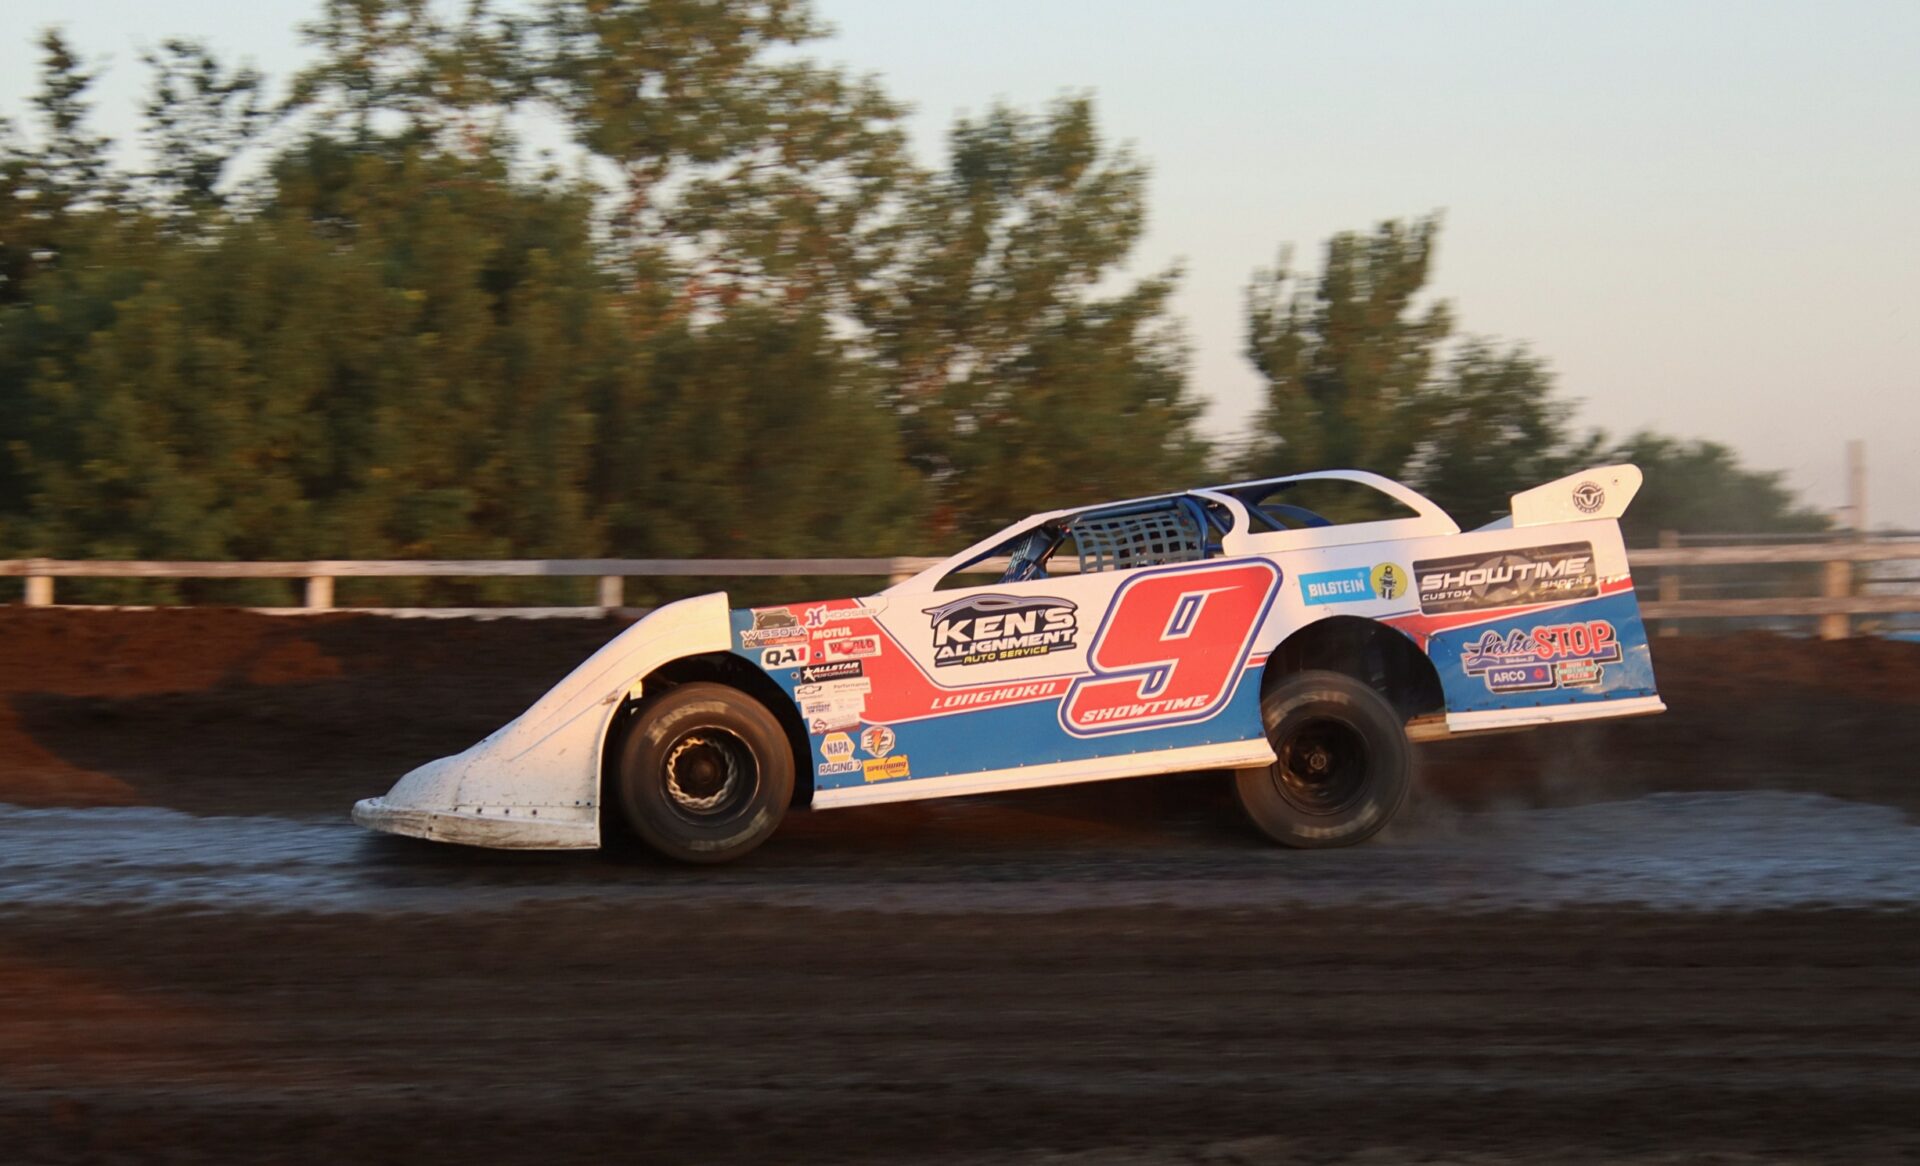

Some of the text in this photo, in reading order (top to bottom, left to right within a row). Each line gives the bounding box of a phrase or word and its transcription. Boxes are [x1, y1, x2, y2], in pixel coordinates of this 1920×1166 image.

[1421, 556, 1590, 592] SHOWTIME
[1540, 575, 1593, 589] SHOCKS
[1308, 578, 1366, 598] BILSTEIN
[1421, 588, 1473, 602] CUSTOM
[812, 627, 852, 640] MOTUL
[935, 607, 1076, 646] KEN'S
[1060, 557, 1282, 737] 9
[1466, 622, 1611, 666] Lake STOP
[765, 646, 807, 666] QA1
[963, 645, 1049, 664] AUTO SERVICE
[813, 661, 860, 674] ALLSTAR
[1493, 670, 1527, 683] ARCO
[1079, 694, 1210, 724] SHOWTIME
[826, 741, 850, 755] NAPA
[820, 762, 853, 774] RACING
